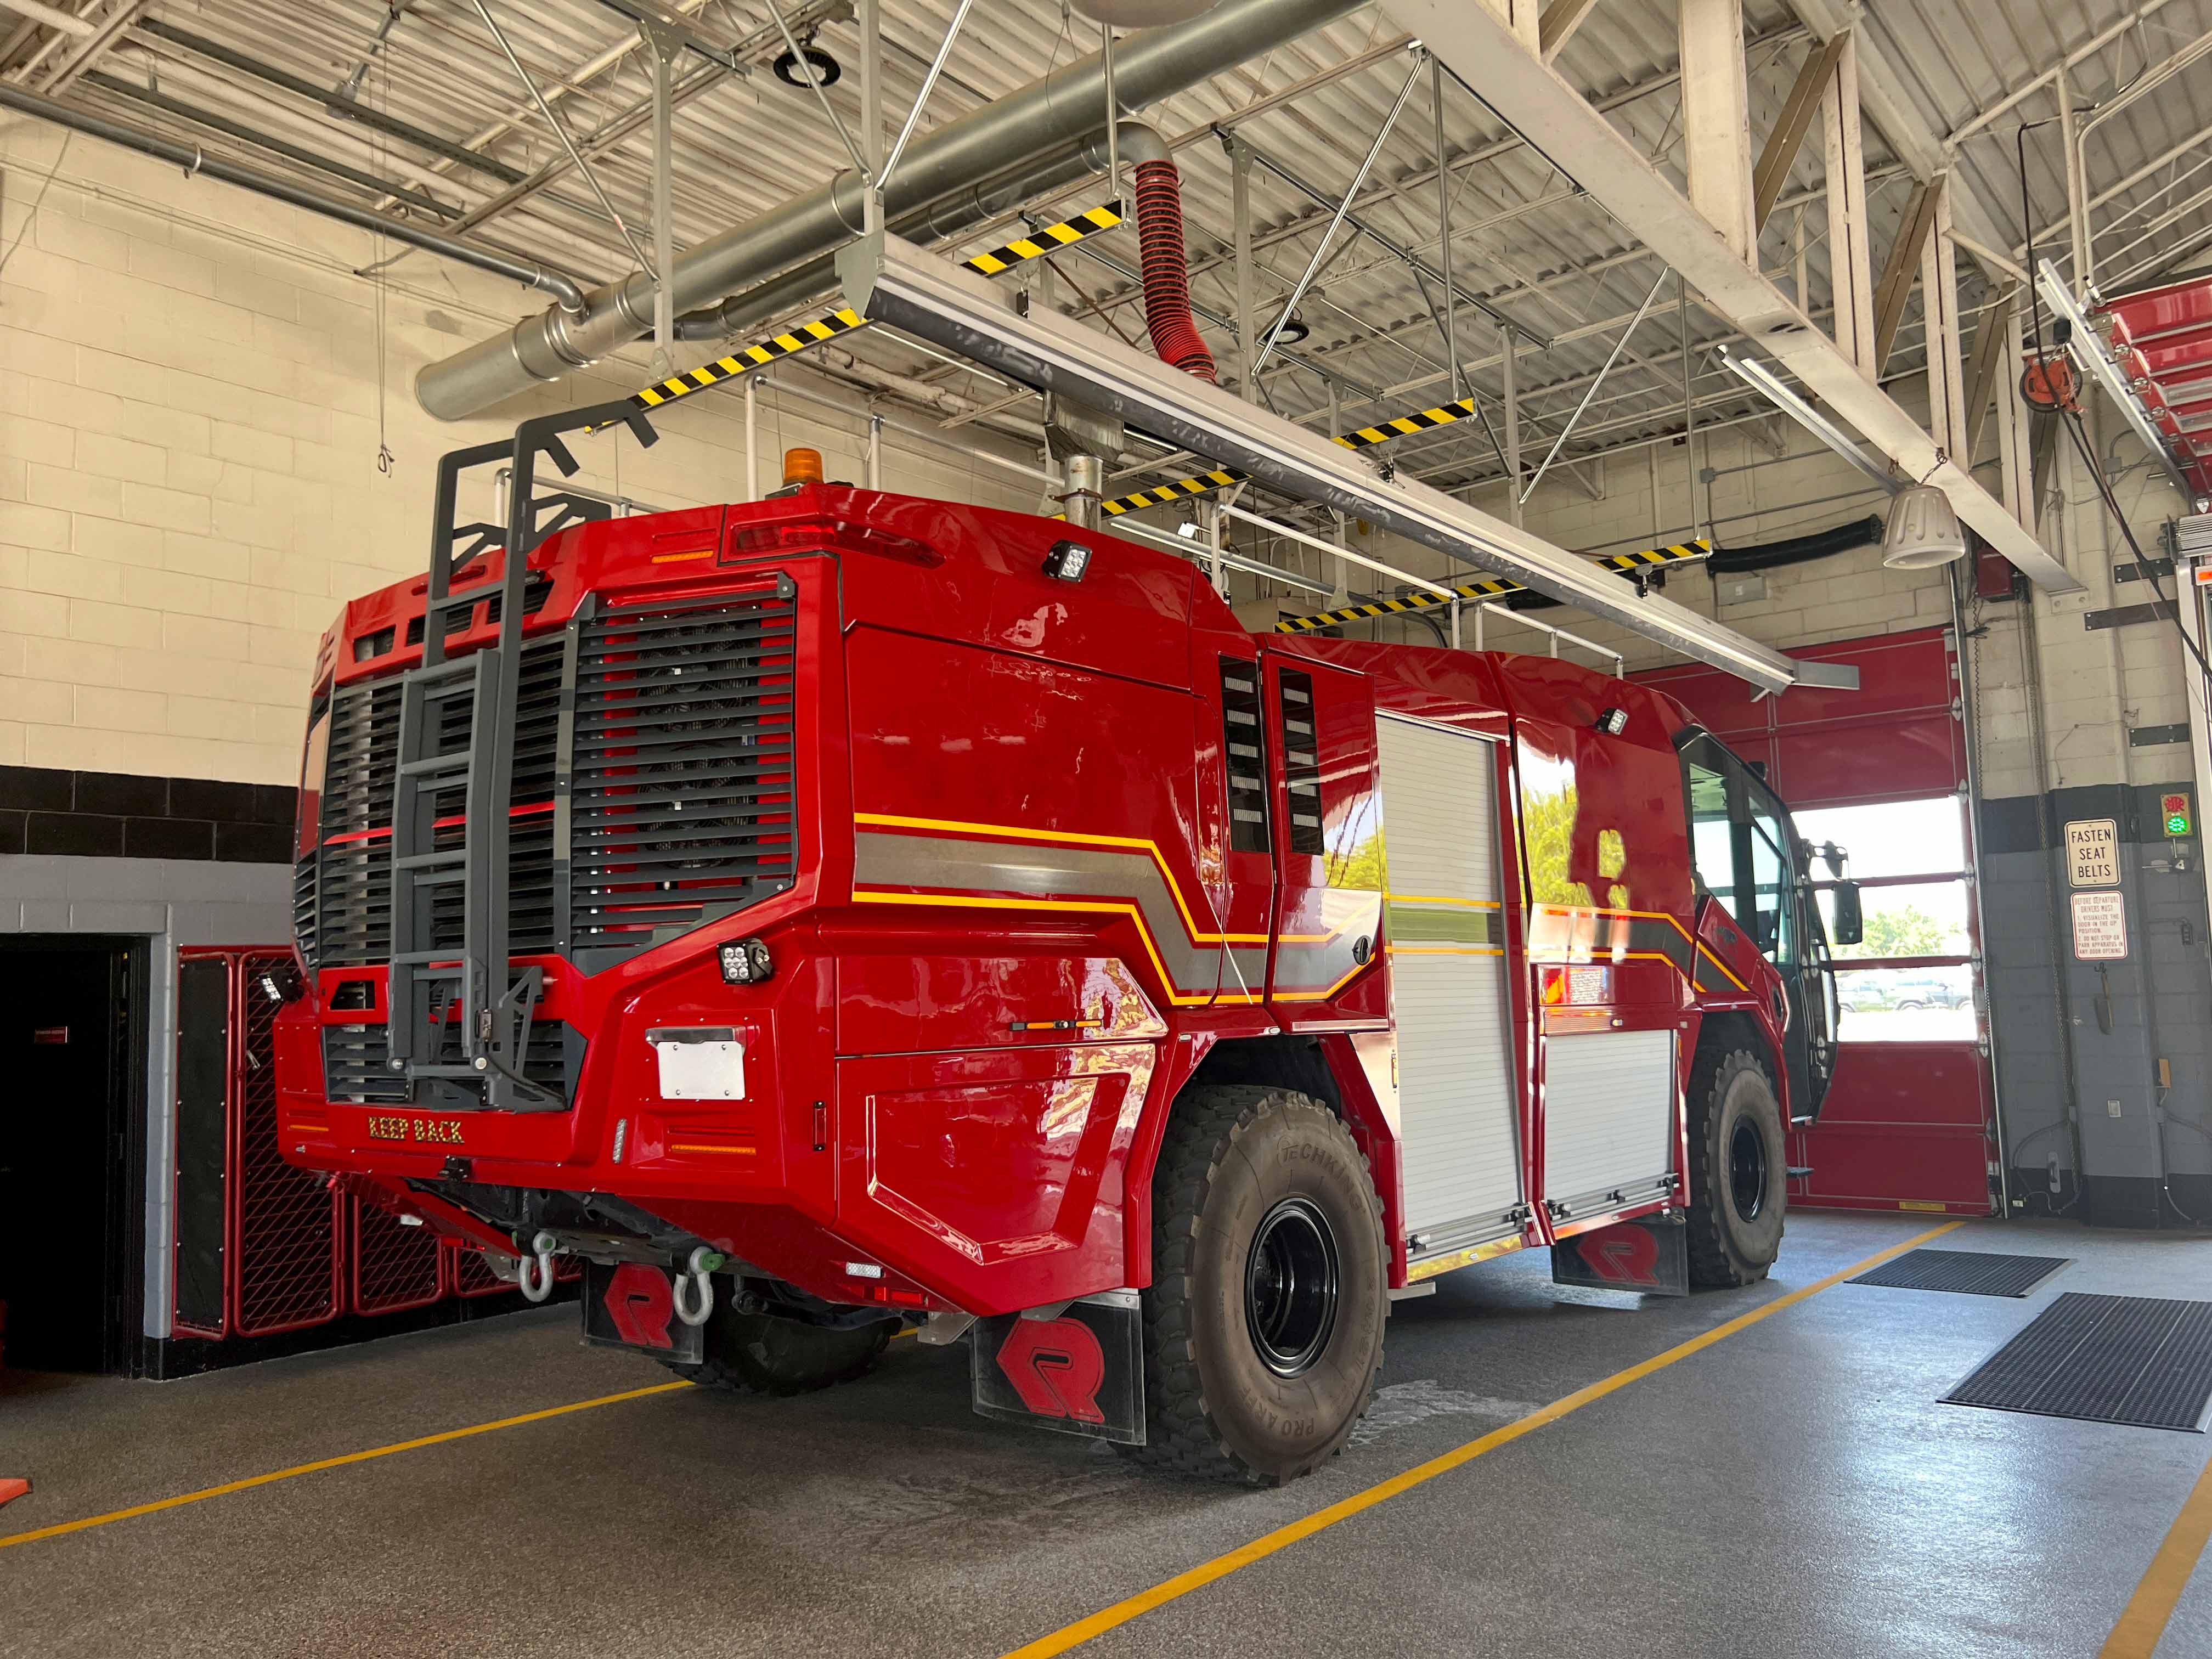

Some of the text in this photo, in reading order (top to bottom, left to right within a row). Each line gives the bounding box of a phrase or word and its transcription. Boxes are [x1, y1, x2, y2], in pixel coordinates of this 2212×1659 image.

[2071, 828, 2111, 844] FASTEN
[2079, 847, 2106, 860] SEAT
[2078, 864, 2111, 878] BELTS
[368, 1116, 465, 1143] KEEP BACK
